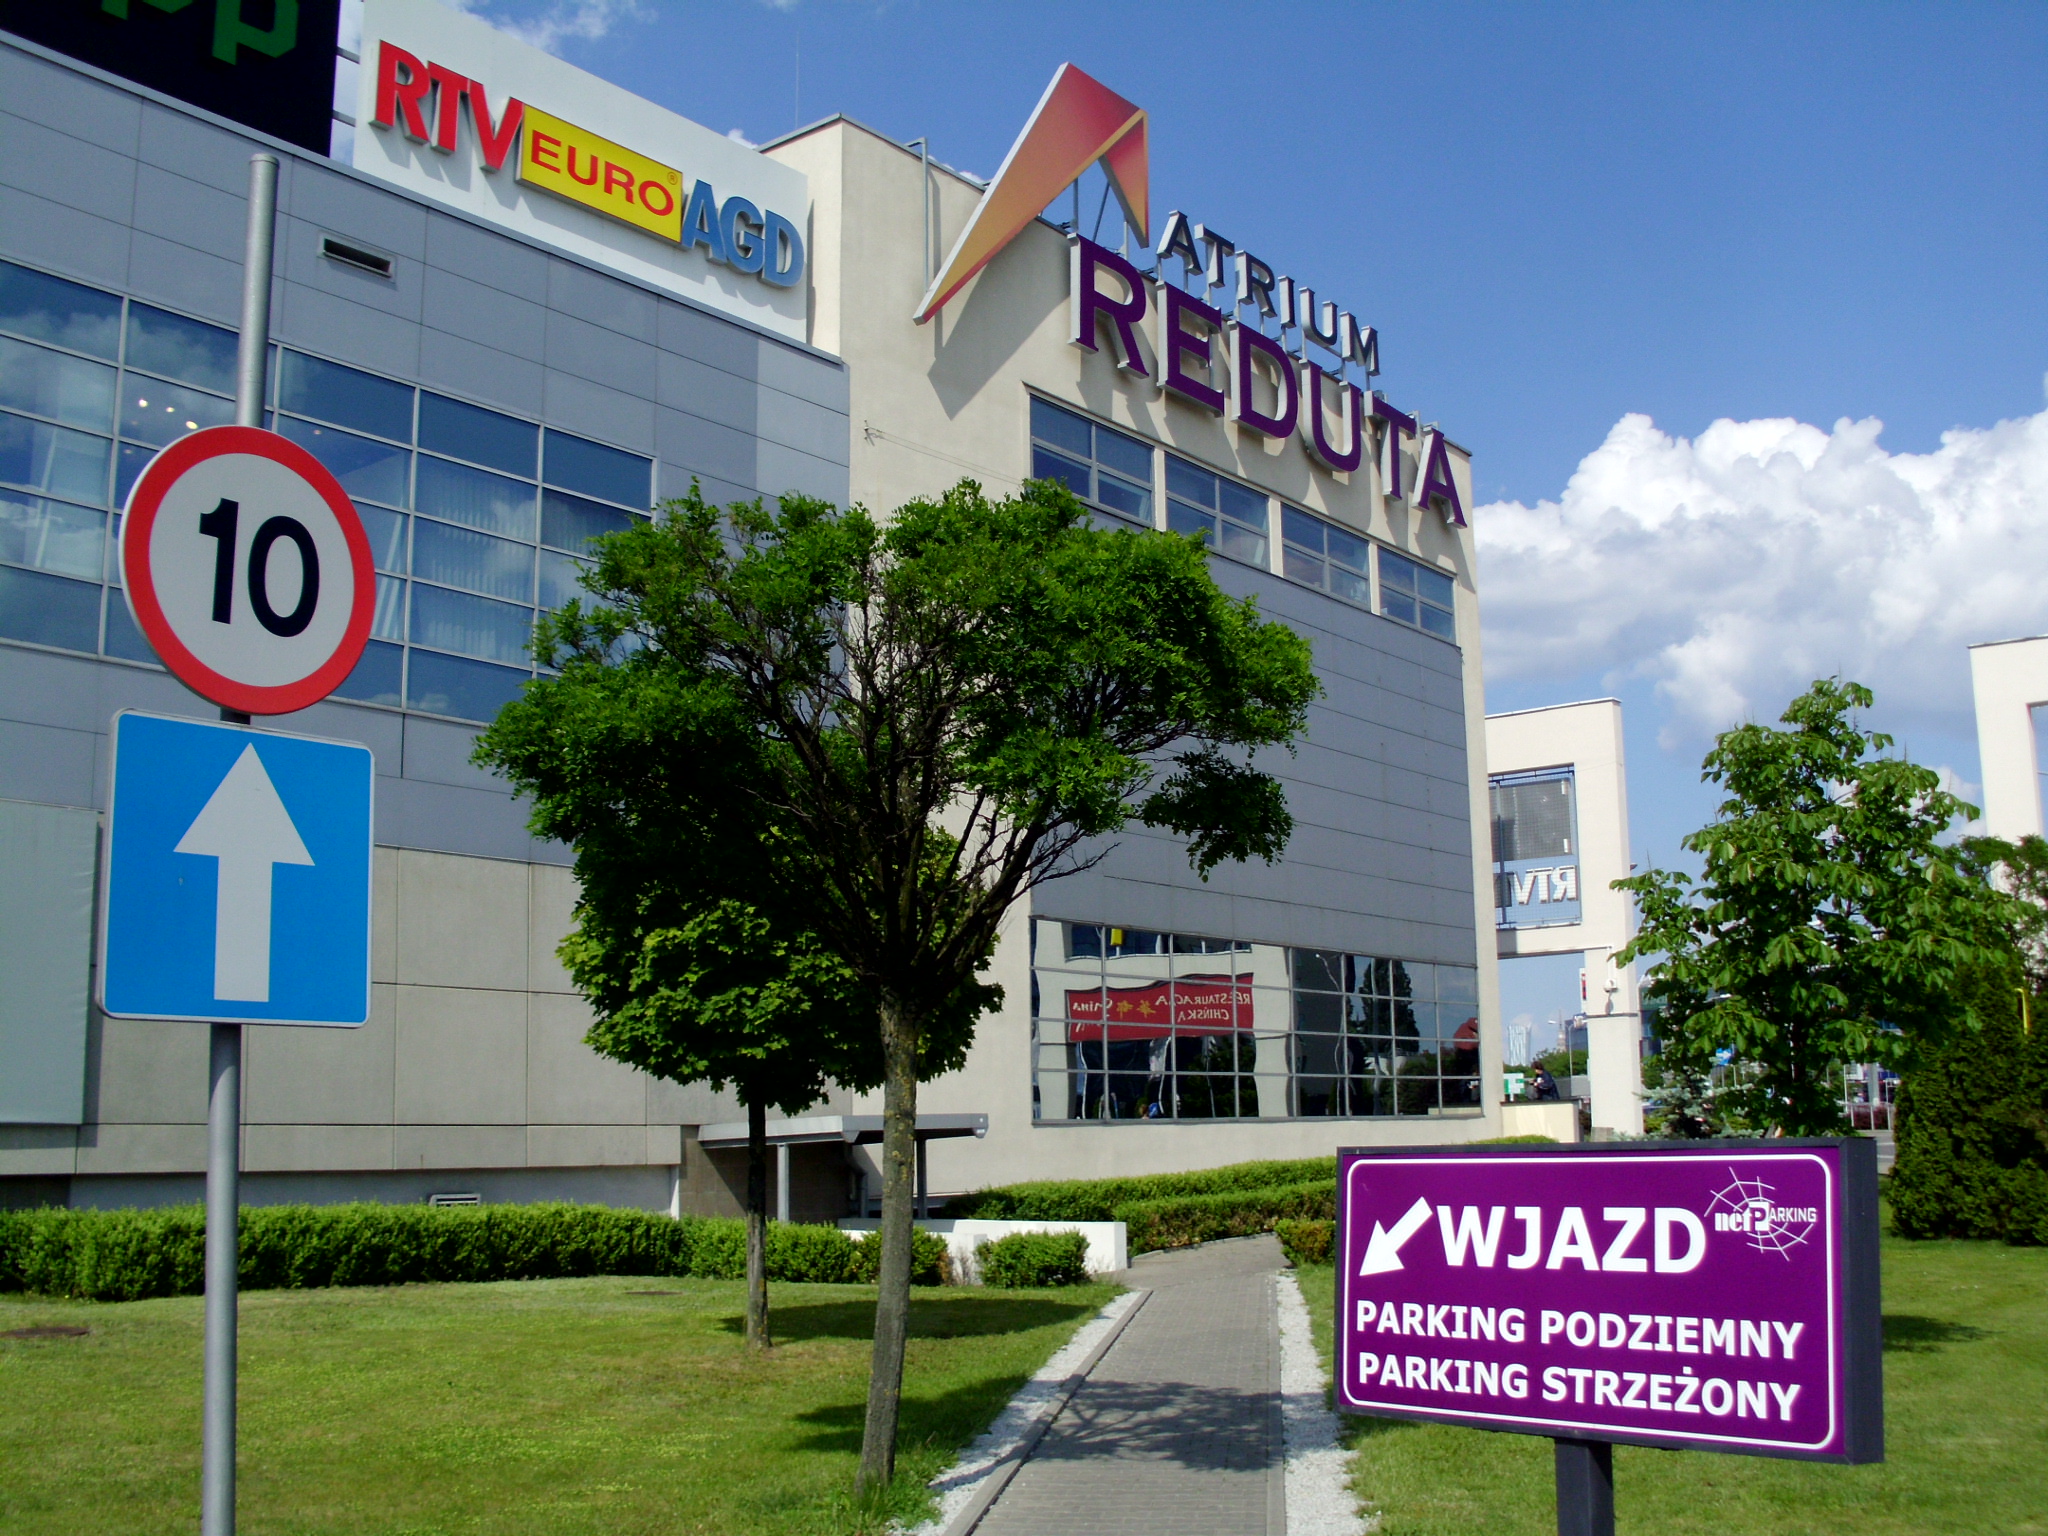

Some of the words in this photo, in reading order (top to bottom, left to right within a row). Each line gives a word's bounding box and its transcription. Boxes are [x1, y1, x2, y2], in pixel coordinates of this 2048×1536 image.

[369, 39, 525, 173] RTV
[531, 130, 674, 216] EURO
[681, 178, 805, 288] AGD
[1156, 210, 1381, 376] ATRIUM
[1068, 233, 1468, 529] REDUTA
[199, 497, 320, 638] 10
[1437, 1205, 1706, 1274] WJAZD
[1356, 1300, 1526, 1343] PARKING
[1540, 1309, 1804, 1359] PODZIEMNY
[1359, 1352, 1529, 1399] PARKING
[1542, 1366, 1801, 1421] STRZEŻONY
